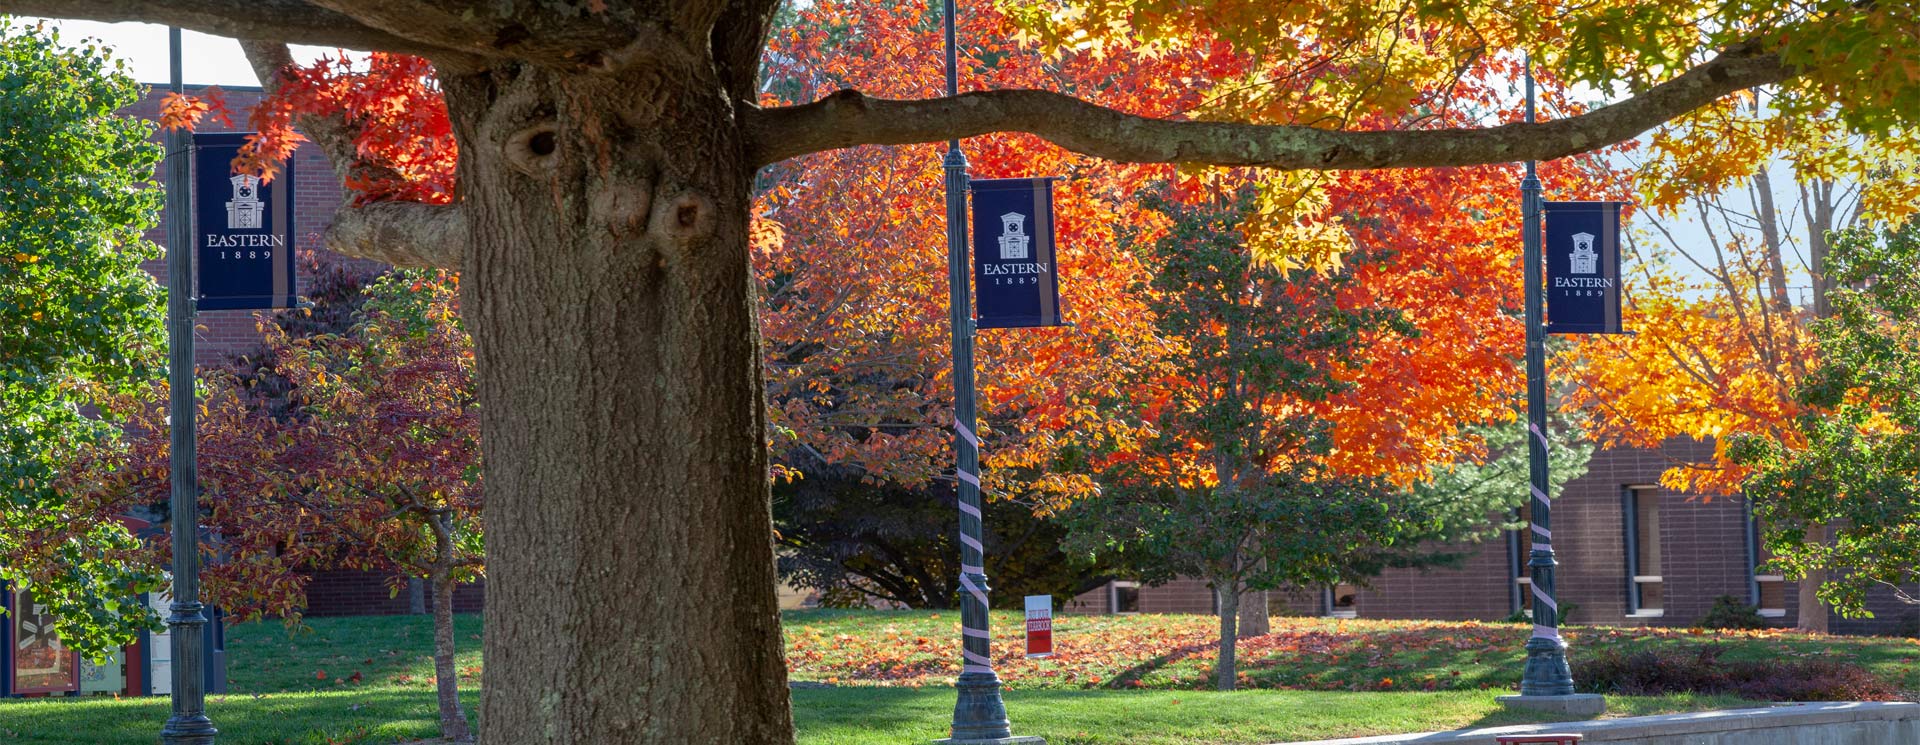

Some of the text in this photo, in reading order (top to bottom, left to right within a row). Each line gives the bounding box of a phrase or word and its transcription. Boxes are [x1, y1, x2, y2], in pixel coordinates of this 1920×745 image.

[206, 234, 284, 247] EASTERN
[221, 251, 271, 259] 1889
[983, 263, 1048, 275] EASTERN
[995, 277, 1037, 285] 1889
[1555, 277, 1613, 287] EASTERN
